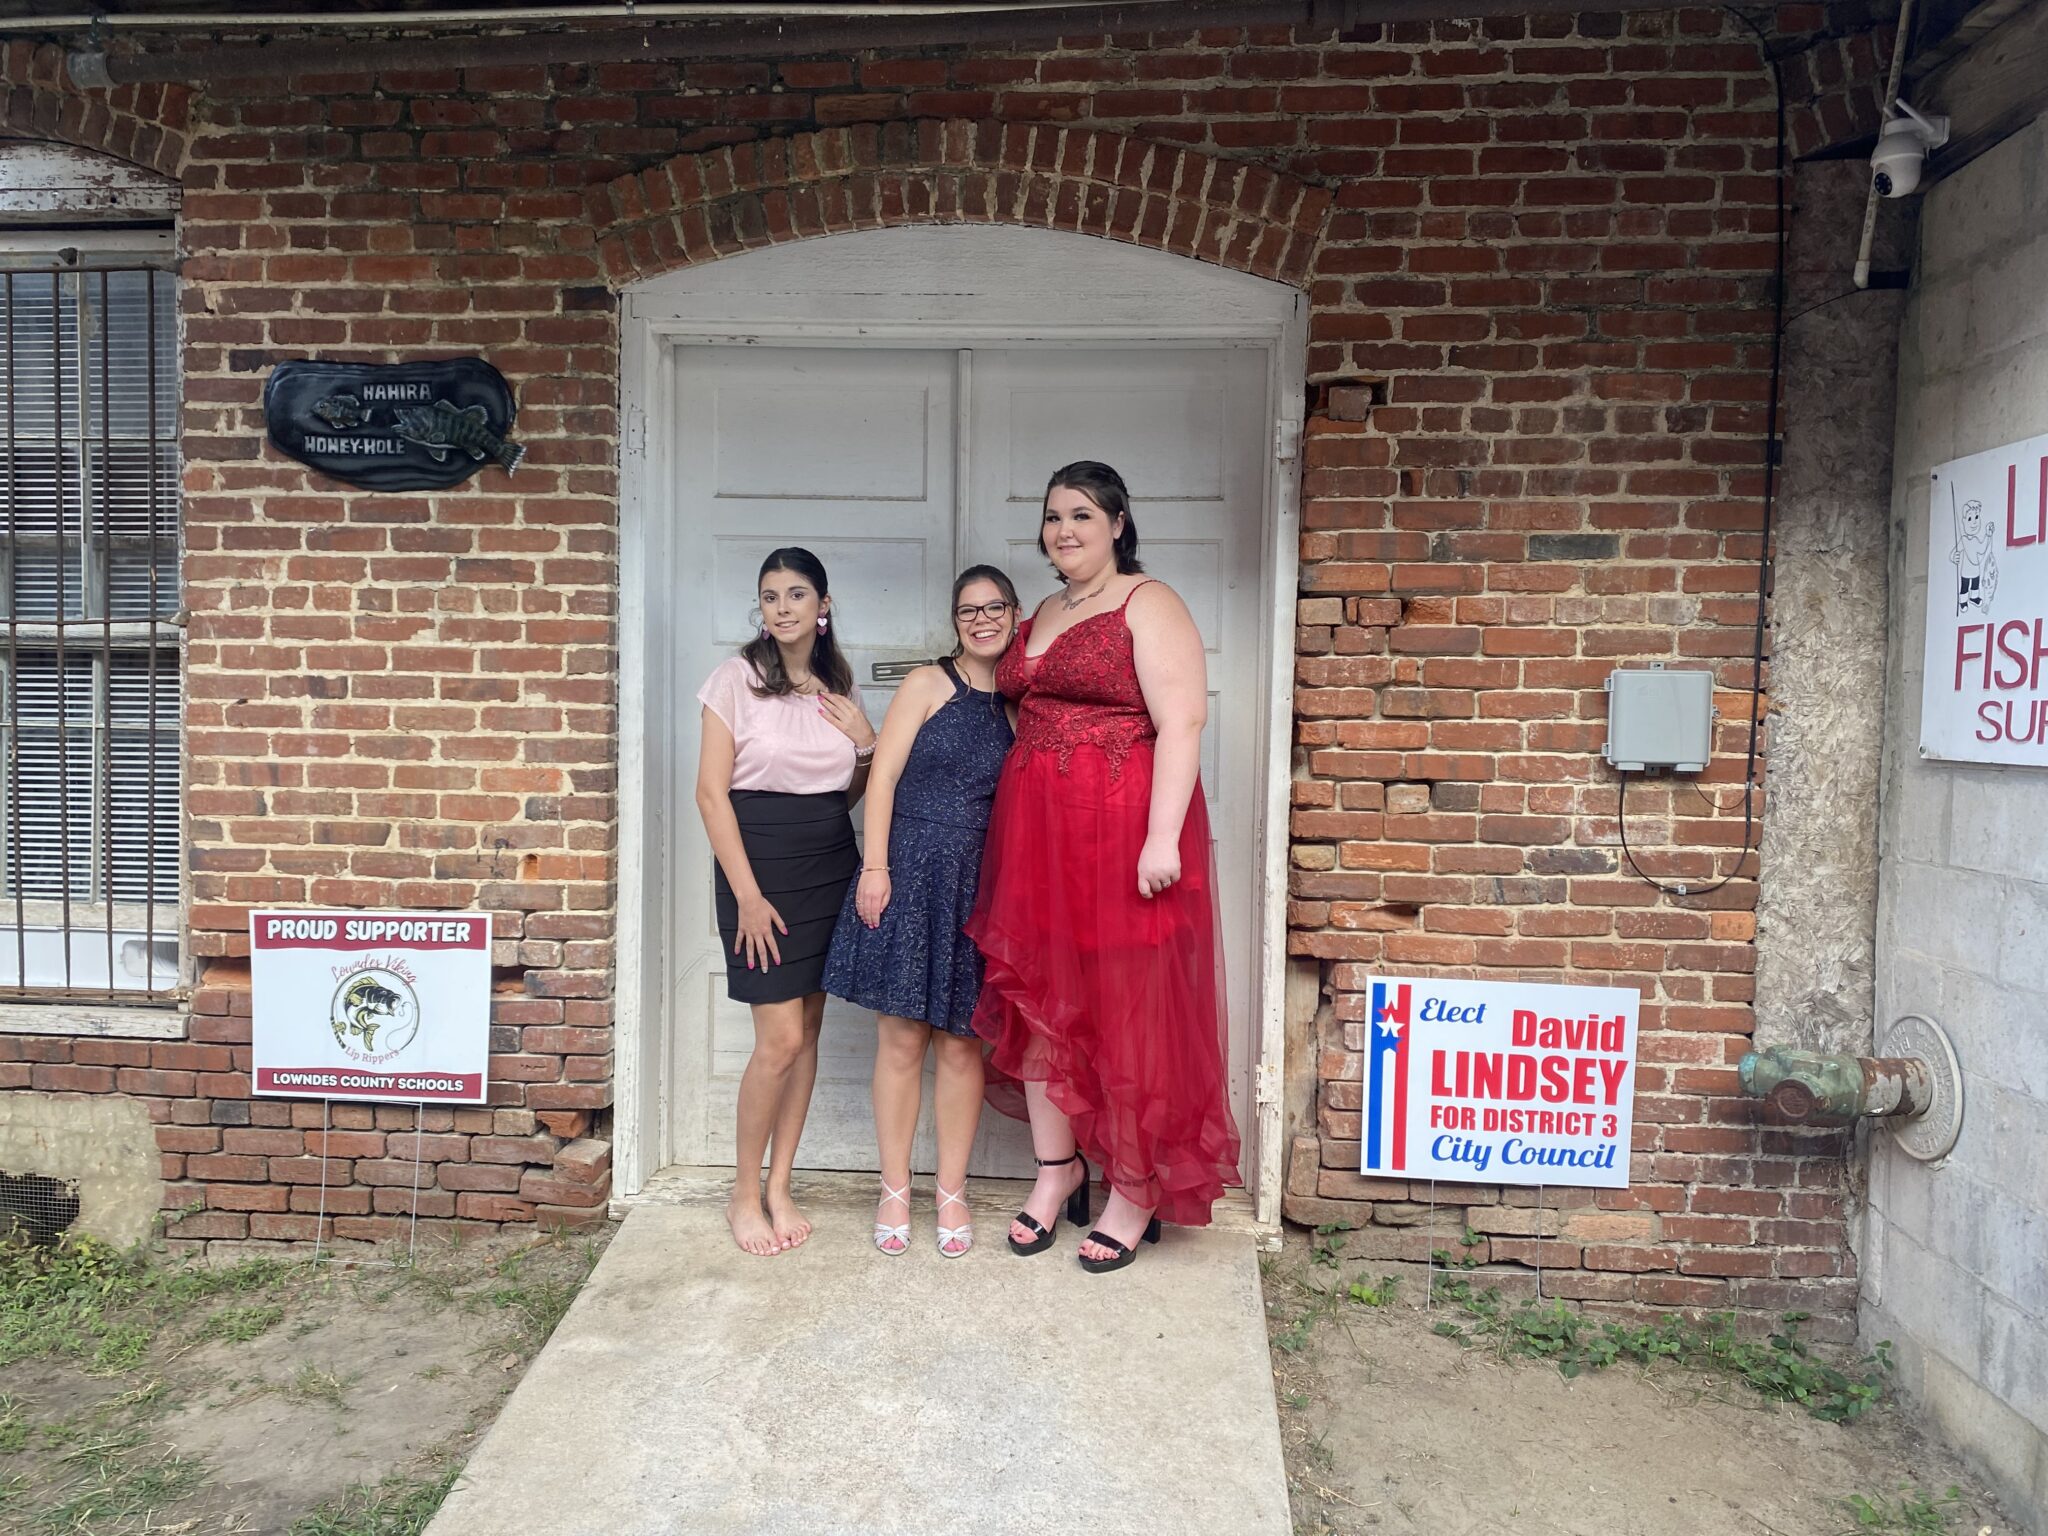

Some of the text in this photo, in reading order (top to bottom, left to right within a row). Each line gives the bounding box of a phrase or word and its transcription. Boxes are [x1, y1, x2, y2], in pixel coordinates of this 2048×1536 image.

[363, 383, 432, 401] HAHIRA
[304, 435, 405, 455] HONEY-HOLE
[267, 919, 471, 943] PROUD SUPPORTER
[331, 953, 418, 987] Lowndes Viking
[1419, 997, 1487, 1024] Elect
[1511, 1009, 1626, 1053] David
[344, 1046, 400, 1065] Lip Rippers
[272, 1072, 465, 1092] LOWNDES COUNTY SCHOOLS
[1430, 1049, 1629, 1106] LINDSEY
[1430, 1105, 1618, 1138] FOR DISTRICT 3
[1431, 1134, 1617, 1171] City Council
